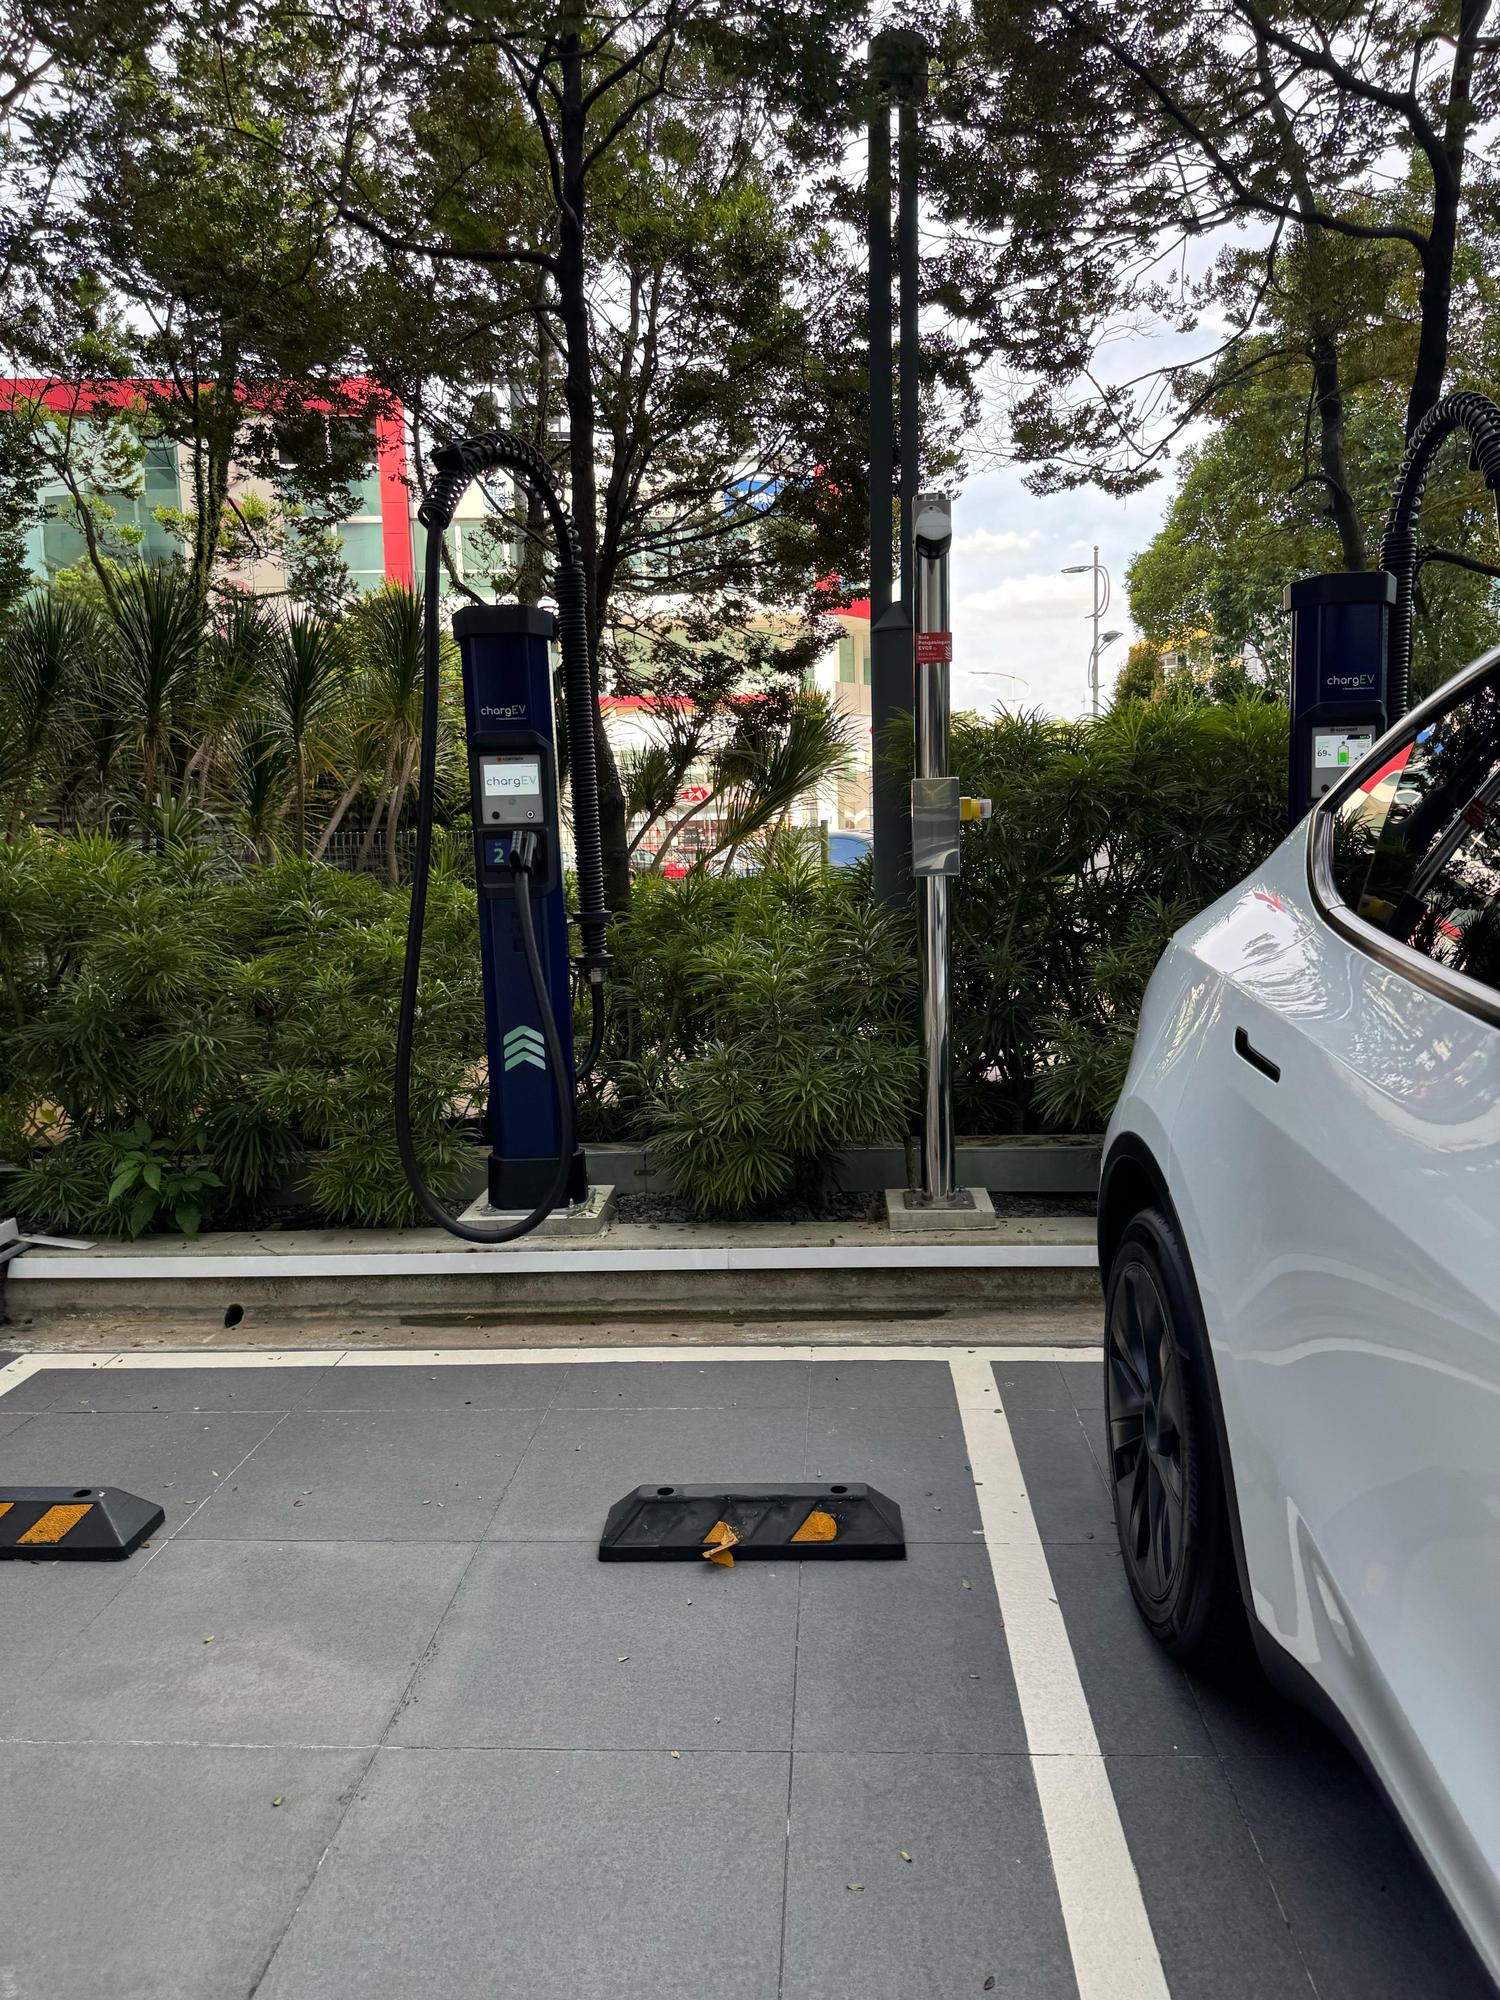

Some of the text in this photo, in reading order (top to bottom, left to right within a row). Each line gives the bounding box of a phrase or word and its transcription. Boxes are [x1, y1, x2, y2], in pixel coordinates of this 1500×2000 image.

[1327, 674, 1375, 686] chargEV
[480, 704, 526, 716] chargEV
[486, 776, 537, 788] chargEV
[493, 848, 504, 863] 2
